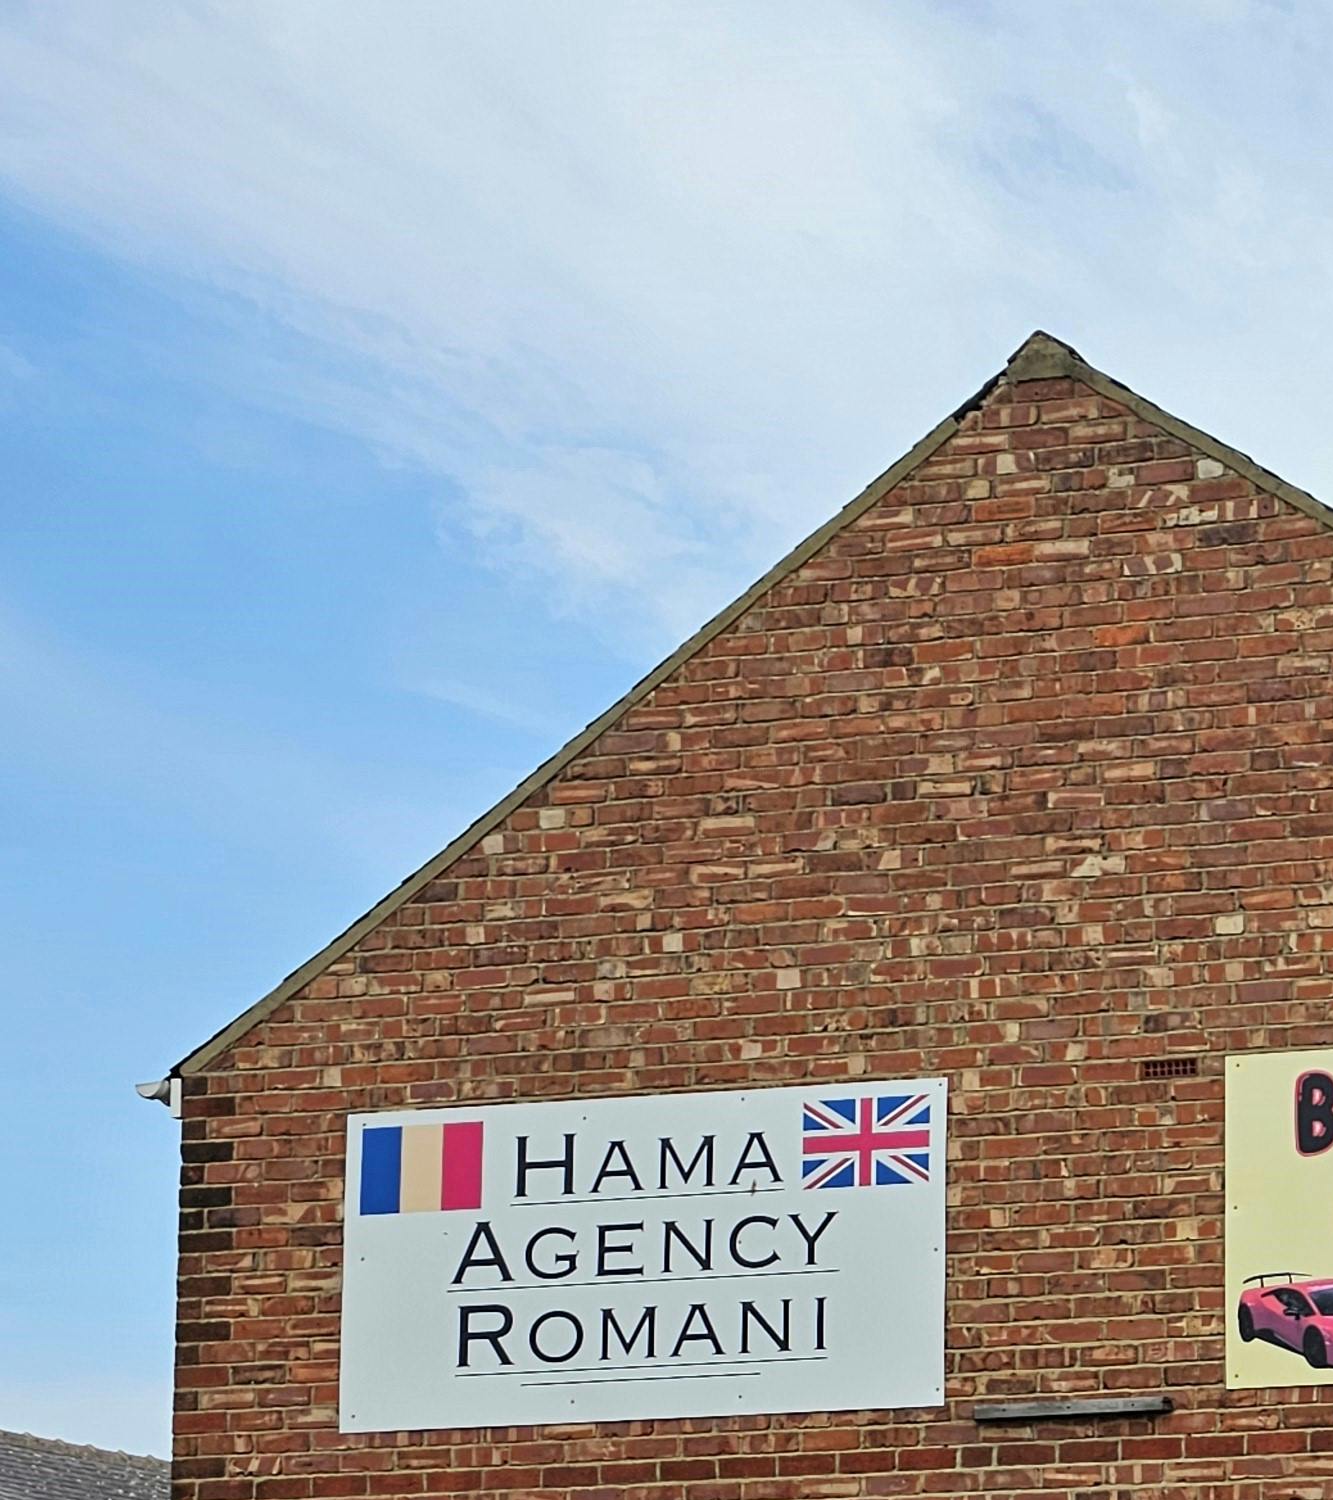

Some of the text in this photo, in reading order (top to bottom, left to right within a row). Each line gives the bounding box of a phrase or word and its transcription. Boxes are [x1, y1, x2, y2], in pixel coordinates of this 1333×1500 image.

[513, 1131, 785, 1198] HAMA
[450, 1211, 840, 1285] AGENCY
[455, 1296, 828, 1368] ROMANI
